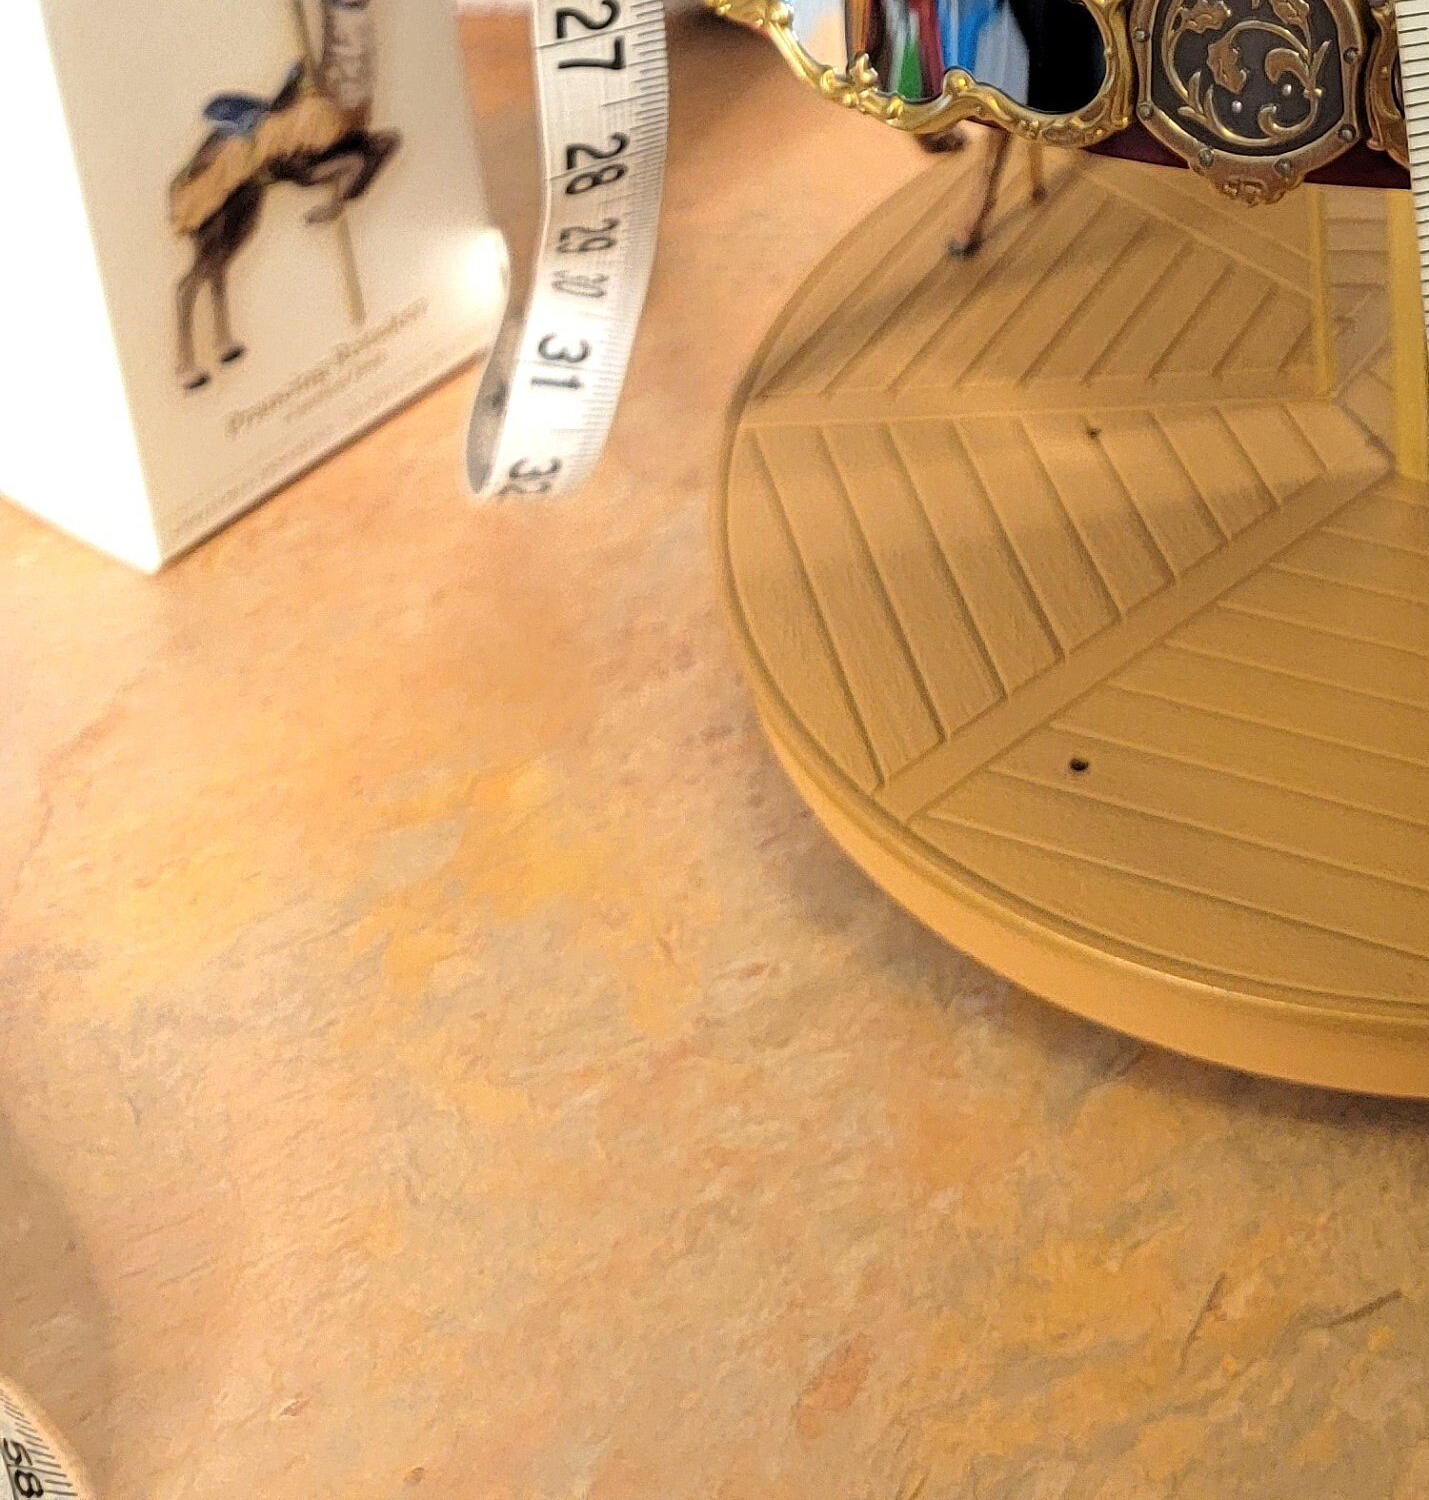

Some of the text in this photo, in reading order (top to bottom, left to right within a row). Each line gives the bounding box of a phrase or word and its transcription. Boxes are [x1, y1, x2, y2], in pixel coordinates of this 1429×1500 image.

[556, 0, 626, 71] 27
[565, 132, 630, 195] 28
[531, 333, 591, 390] 31
